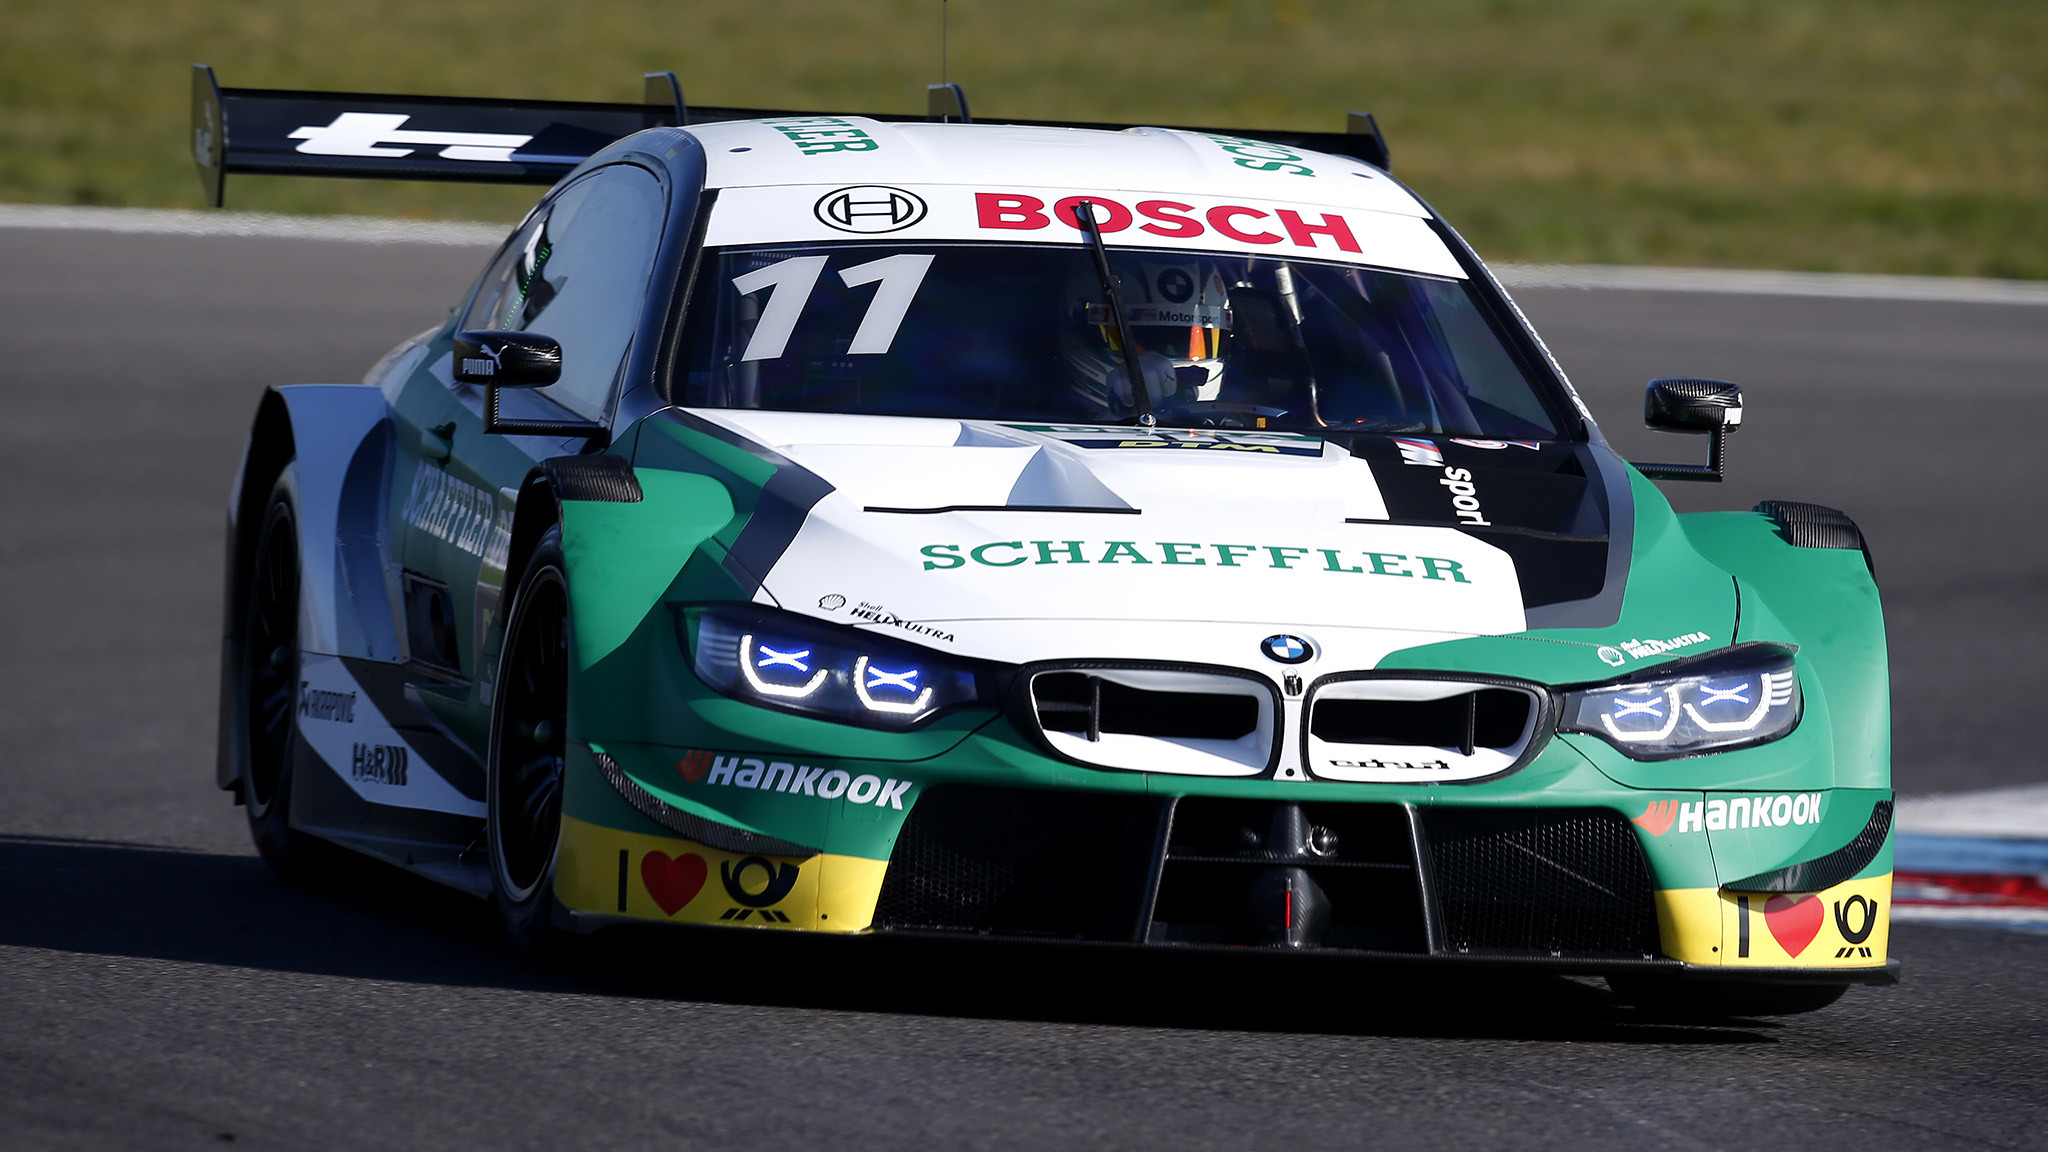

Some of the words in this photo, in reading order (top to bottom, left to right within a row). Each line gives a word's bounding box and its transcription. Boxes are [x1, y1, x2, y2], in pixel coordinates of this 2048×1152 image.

[975, 192, 1363, 254] BOSCH
[731, 253, 936, 362] 11
[462, 357, 495, 376] PUMA
[1118, 440, 1280, 454] DTM
[1439, 466, 1492, 527] sport
[919, 540, 1473, 585] SCHAEFFLER
[904, 621, 955, 642] ULTRA
